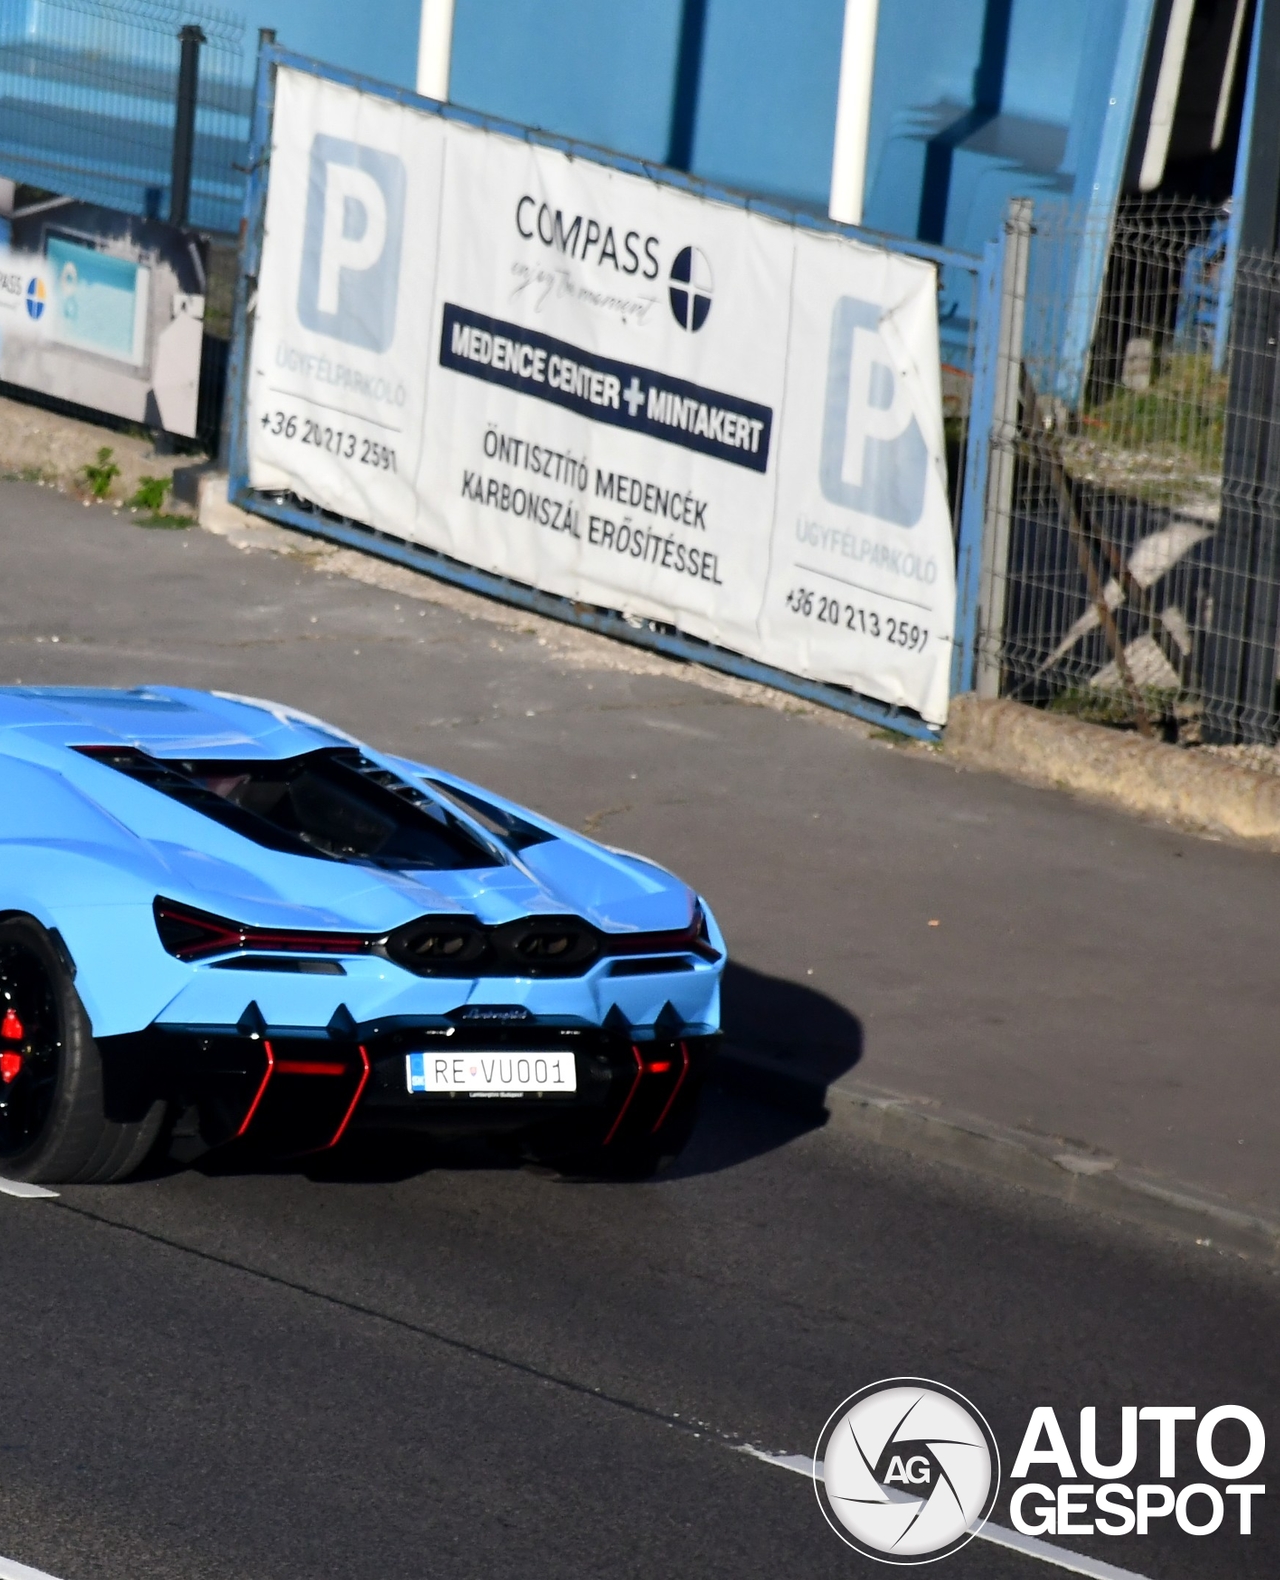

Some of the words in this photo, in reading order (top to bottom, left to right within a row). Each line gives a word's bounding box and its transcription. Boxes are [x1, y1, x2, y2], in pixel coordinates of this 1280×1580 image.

[516, 195, 660, 280] COMPASS
[261, 411, 297, 440] +36
[451, 321, 548, 384] MEDENCE
[547, 357, 621, 410] CENTER
[646, 387, 765, 454] MINTAKERT
[484, 422, 589, 492] ÖNTISZTÍTÓ
[595, 468, 709, 531] MEDENCÉK
[461, 469, 582, 540] KARBONSZÁL
[588, 515, 724, 585] ERŐSÍTÉSSEL
[786, 588, 815, 617] +36
[817, 596, 840, 626] 20
[845, 605, 881, 637] 213
[886, 617, 929, 653] 2591
[435, 1059, 466, 1084] RE
[480, 1059, 566, 1084] VU001
